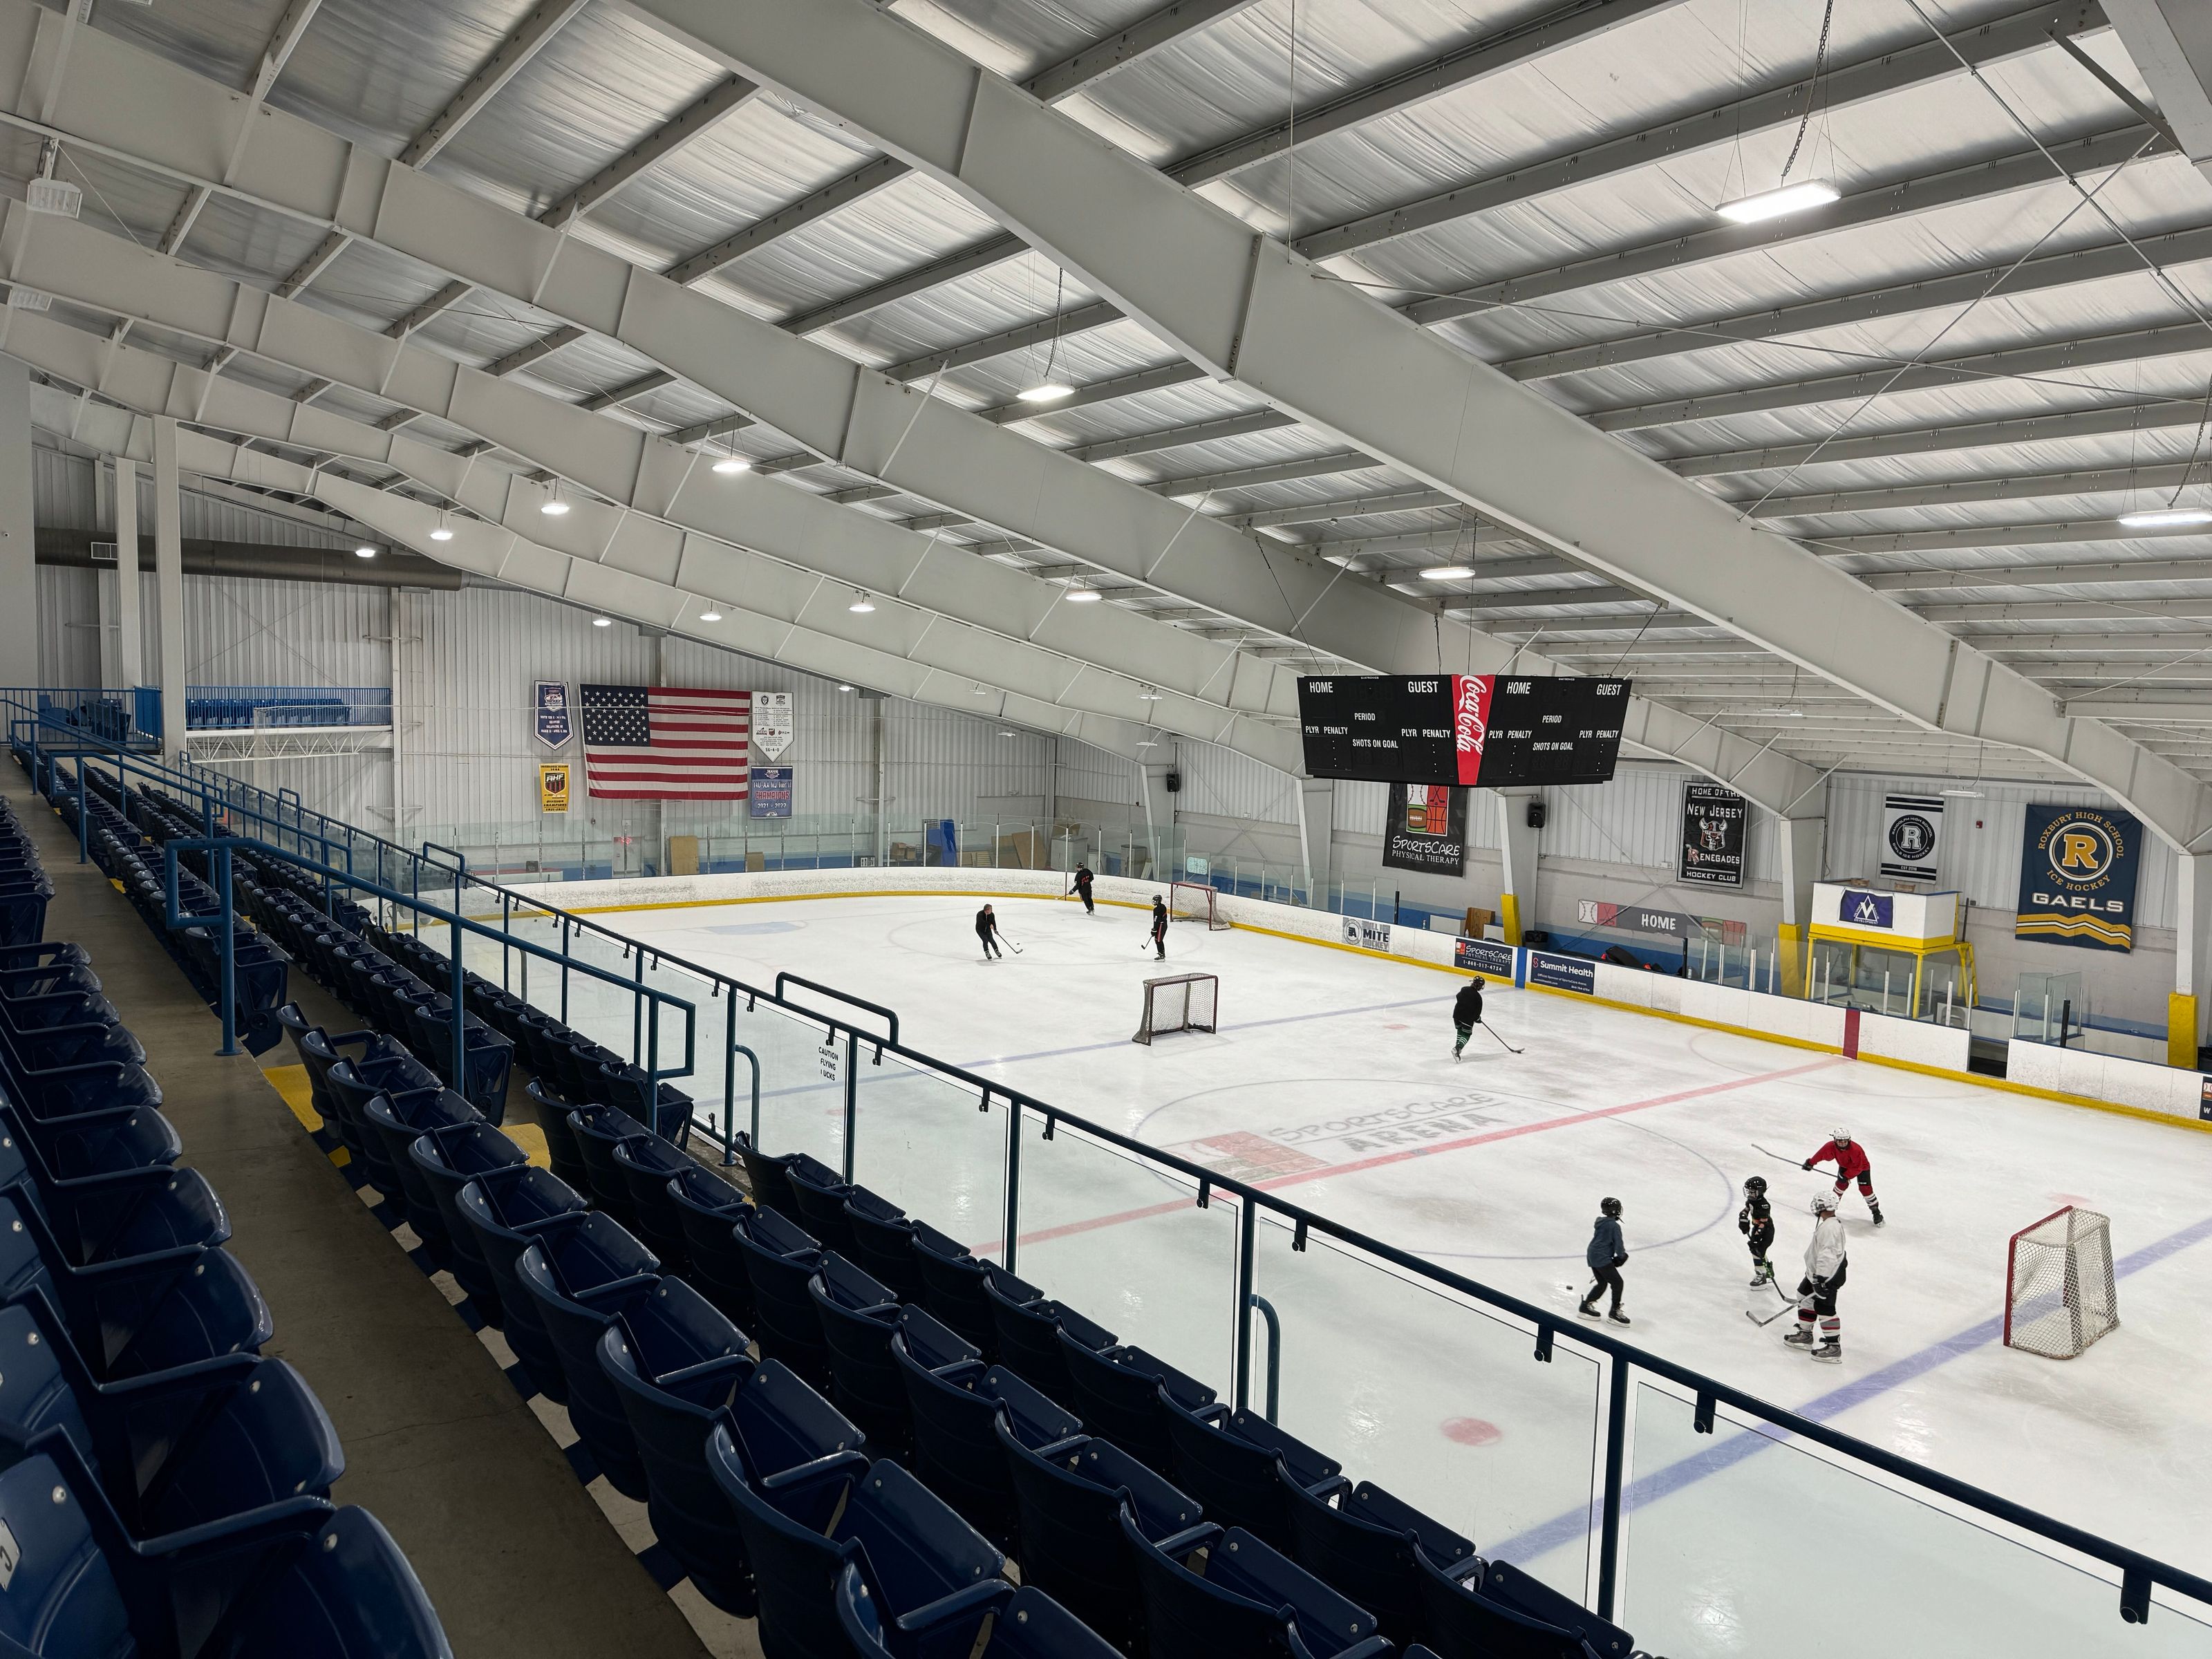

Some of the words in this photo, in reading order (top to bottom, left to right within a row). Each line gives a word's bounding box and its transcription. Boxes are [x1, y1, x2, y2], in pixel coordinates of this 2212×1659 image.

[1309, 682, 1333, 693] HOME
[1408, 681, 1438, 693] GUEST
[1506, 682, 1531, 694] HOME
[1596, 684, 1622, 695] GUEST
[1354, 713, 1376, 721] PERIOD
[1456, 675, 1487, 756] Coca-Cola
[1542, 715, 1562, 723] PERIOD
[1306, 726, 1319, 734] PLYR
[1324, 727, 1348, 735] PENALTY
[1401, 729, 1417, 737] PLYR
[1423, 729, 1451, 738] PENALTY
[1488, 730, 1503, 739] PLYR
[1507, 730, 1532, 739] PENALTY
[1579, 730, 1592, 738] PLYR
[1596, 730, 1619, 738] PENALTY
[1353, 739, 1371, 747] SHOTS
[1382, 740, 1398, 749] GOAL
[1533, 742, 1550, 751] SHOTS
[1551, 742, 1559, 750] ON
[1560, 742, 1573, 751] GOAL
[546, 774, 564, 782] AHF
[755, 791, 790, 800] CHAMPIONS
[1691, 787, 1712, 796] HOME
[1714, 788, 1724, 796] OF
[1922, 821, 1933, 838] SCHOOL
[2038, 814, 2072, 850] ROXBURY
[2075, 812, 2103, 823] HIGH
[2103, 821, 2124, 859] SCHOOL
[1901, 825, 1922, 850] R
[1391, 850, 1424, 861] PHYSICAL
[1426, 854, 1460, 865] THERAPY
[1912, 847, 1930, 859] HOCKEY
[2062, 834, 2098, 869] R
[1687, 871, 1716, 880] HOCKEY
[2047, 870, 2064, 885] ICE
[2065, 874, 2110, 892] HOCKEY
[2032, 892, 2124, 912] GAELS
[1641, 913, 1676, 930] HOME
[1363, 928, 1389, 943] MITE
[1490, 957, 1511, 965] THERAPY
[1540, 960, 1568, 973] Summit
[1568, 966, 1593, 978] Health
[818, 1047, 838, 1061] CAUTION
[820, 1058, 836, 1071] FLYING
[1341, 1113, 1508, 1152] ARENA
